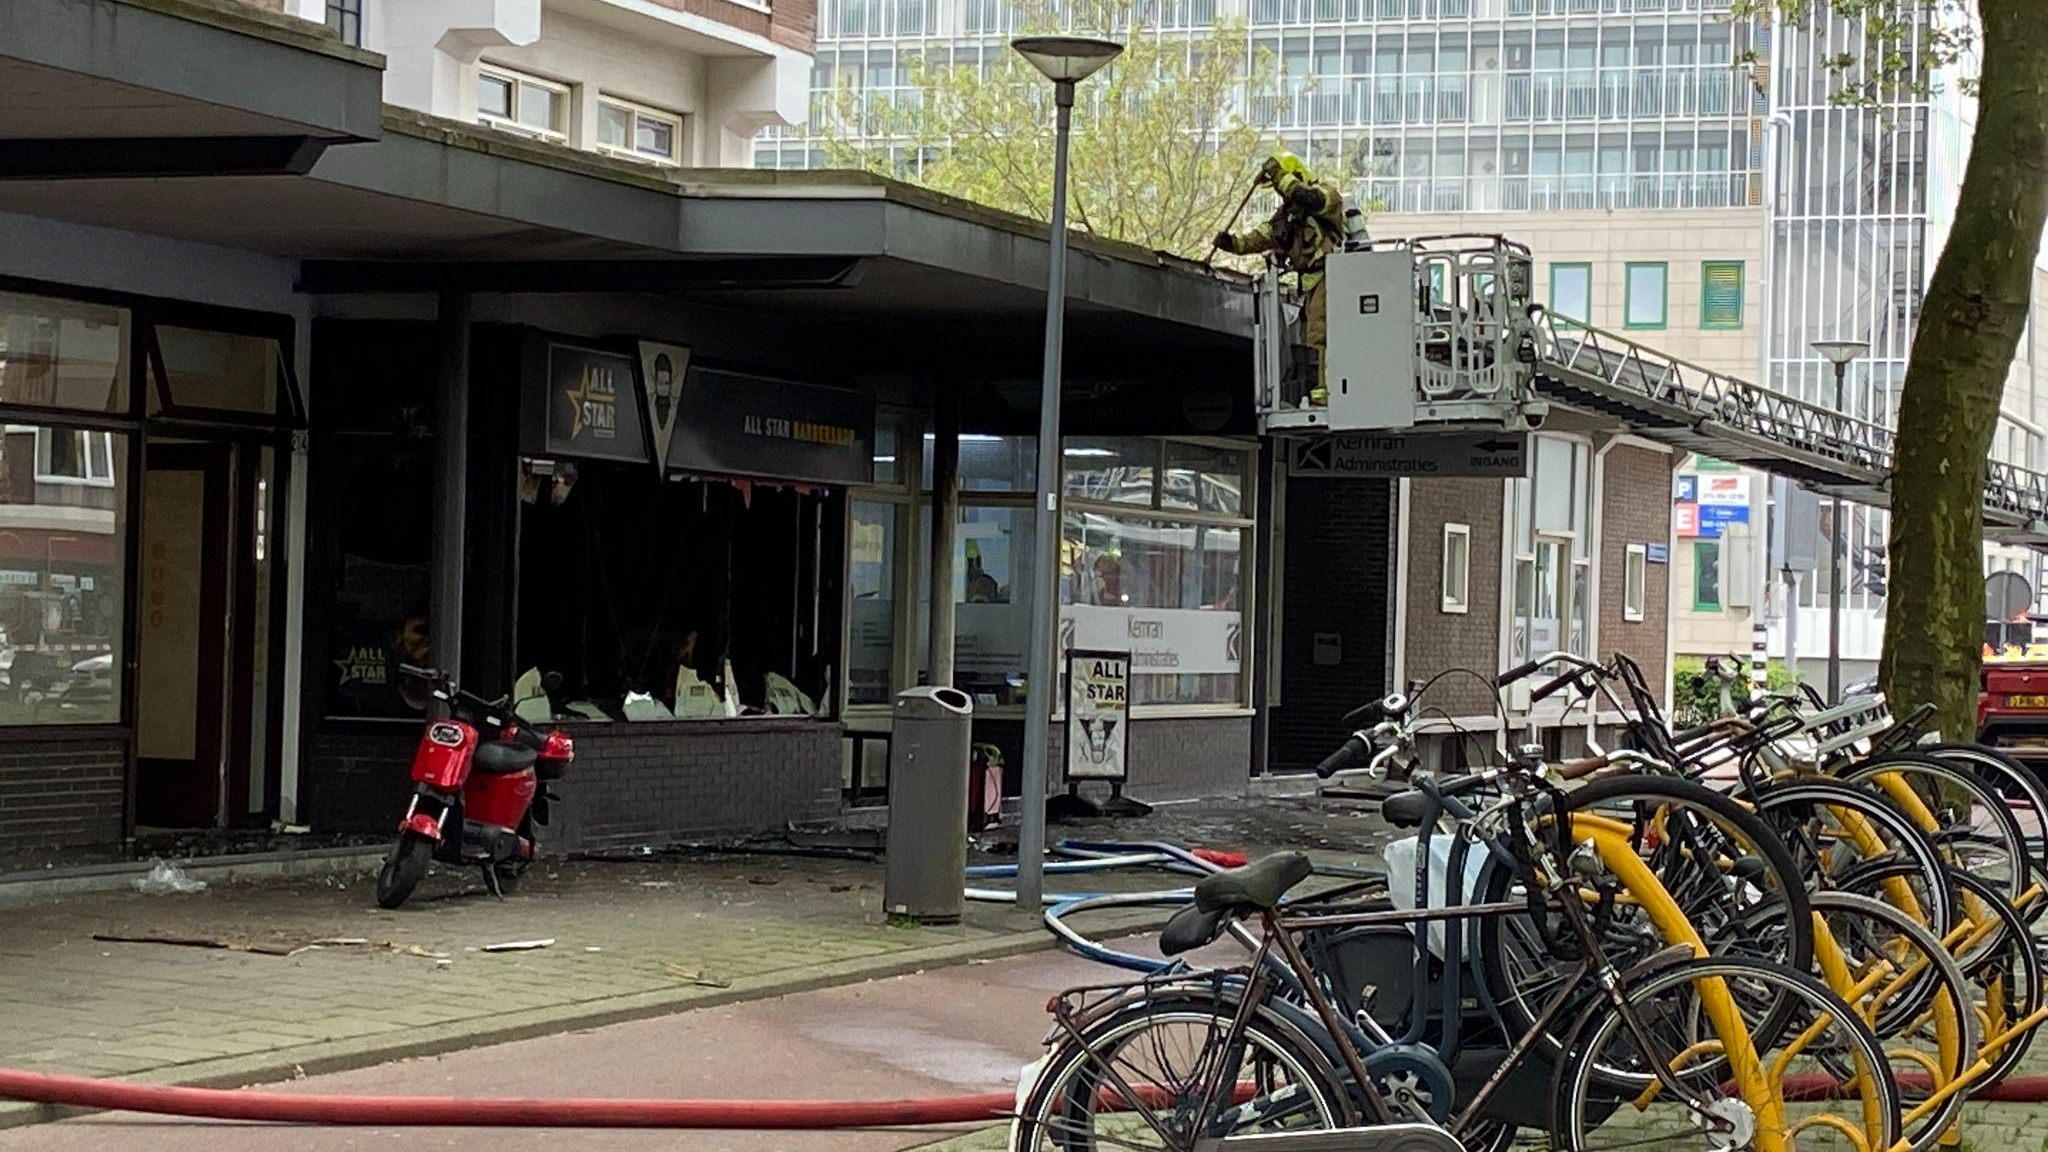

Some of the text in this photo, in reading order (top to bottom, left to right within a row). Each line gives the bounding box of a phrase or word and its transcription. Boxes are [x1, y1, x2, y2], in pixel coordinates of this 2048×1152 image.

[590, 367, 615, 394] ALL
[583, 401, 615, 428] STAR
[744, 415, 762, 436] ALL
[765, 418, 790, 439] STAR
[1335, 436, 1405, 450] Kemran
[1334, 456, 1438, 473] Administraties
[1470, 456, 1520, 467] INGANG
[1677, 508, 1692, 530] E
[1127, 614, 1164, 639] Kemran
[358, 646, 385, 660] ALL
[350, 665, 387, 680] STAR
[1092, 660, 1124, 679] ALL
[1086, 683, 1125, 701] STAR
